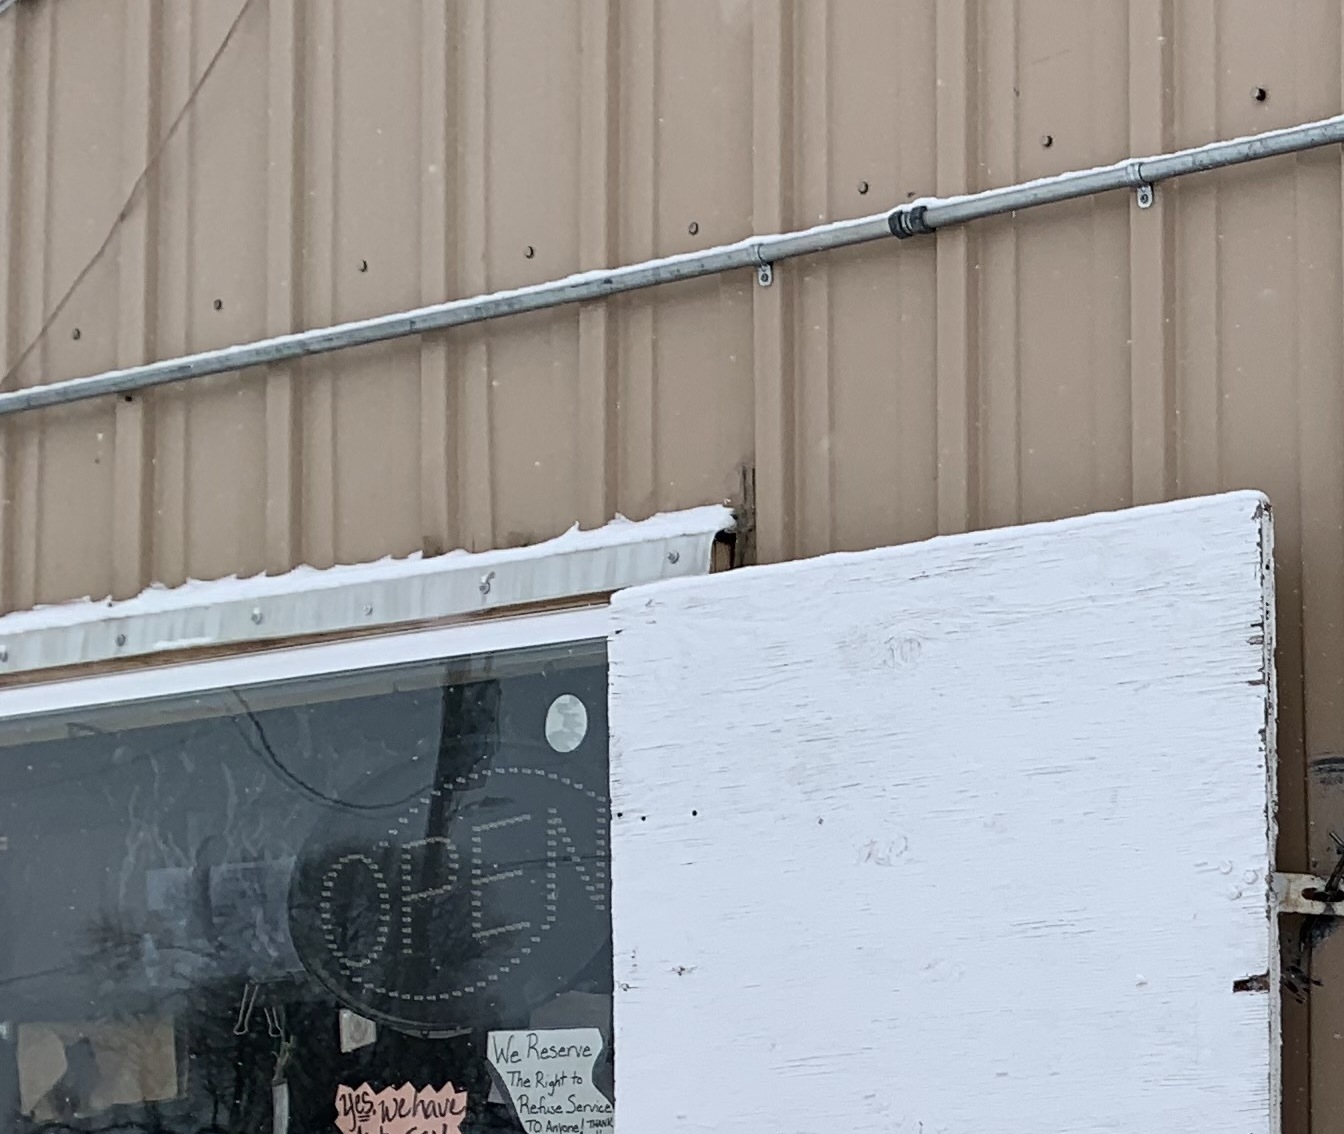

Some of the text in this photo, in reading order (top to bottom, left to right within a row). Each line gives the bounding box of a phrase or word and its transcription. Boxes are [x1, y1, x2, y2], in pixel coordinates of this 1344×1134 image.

[321, 800, 605, 967] OPEN
[493, 1033, 592, 1064] We Reserve
[507, 1071, 583, 1096] The Right to
[412, 1090, 466, 1119] have
[517, 1094, 612, 1114] Refuse Service
